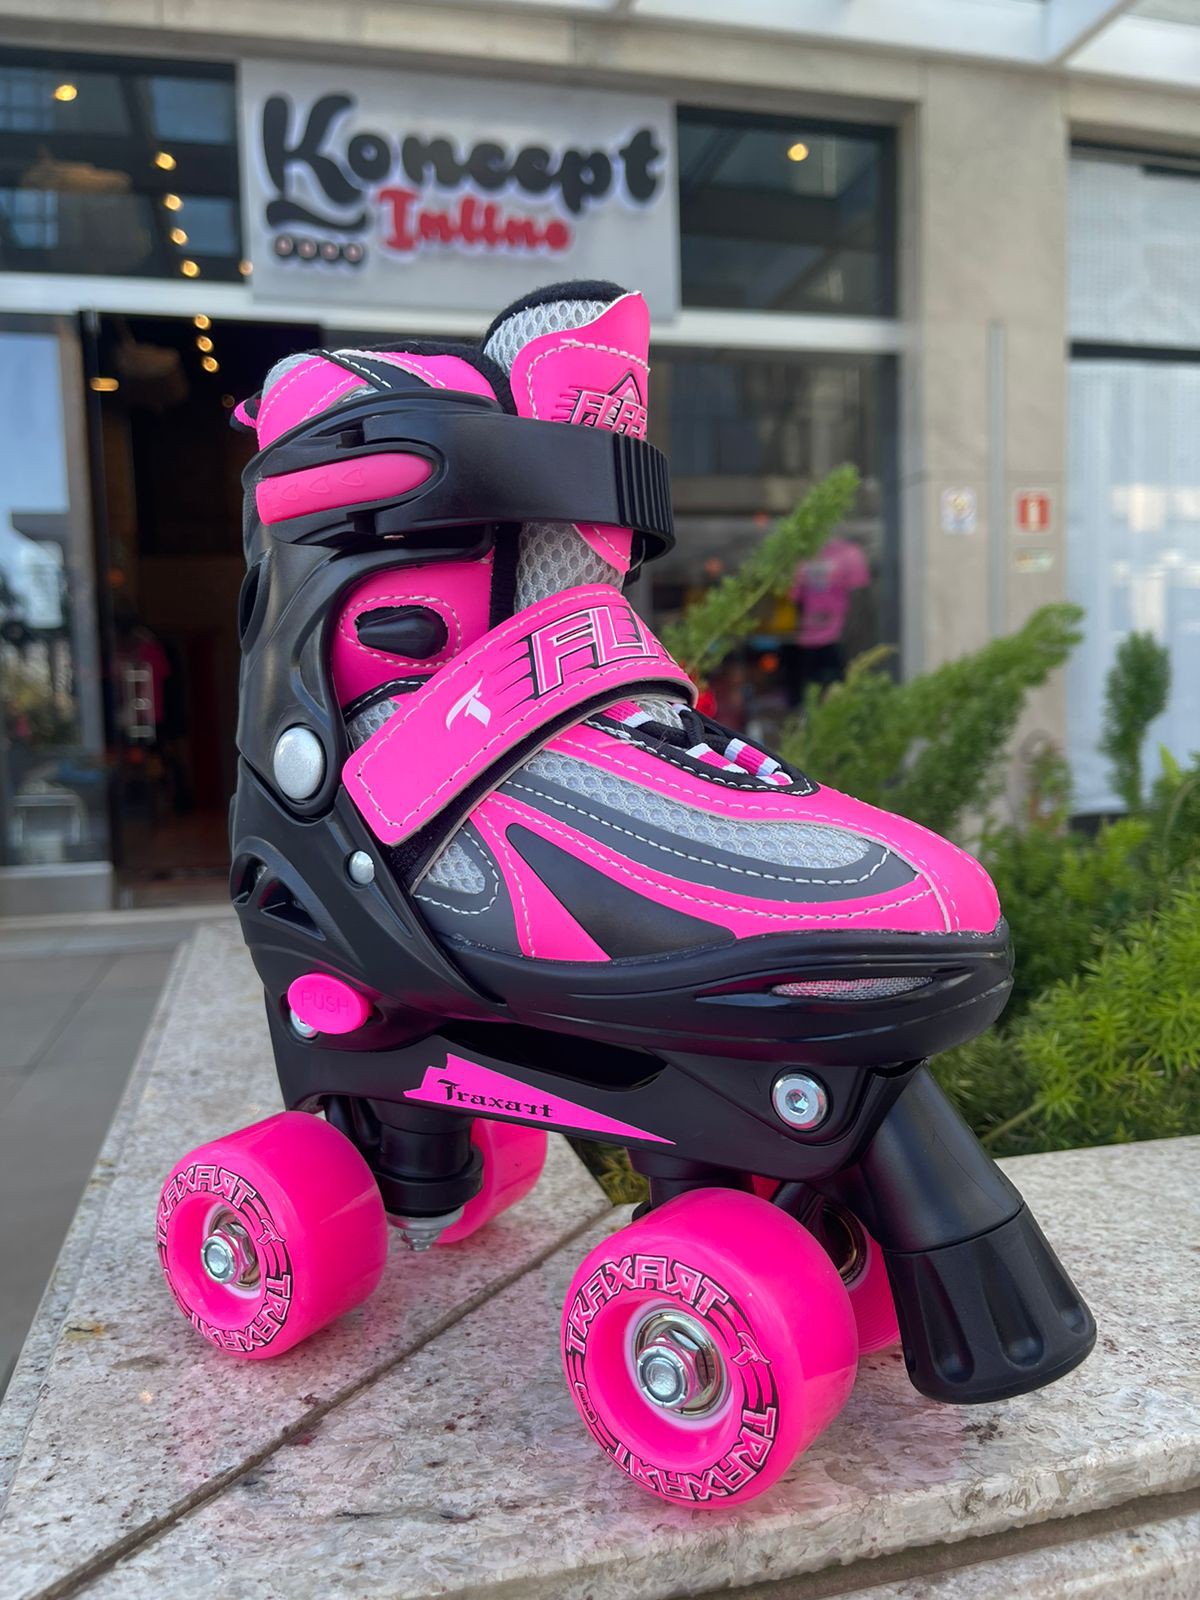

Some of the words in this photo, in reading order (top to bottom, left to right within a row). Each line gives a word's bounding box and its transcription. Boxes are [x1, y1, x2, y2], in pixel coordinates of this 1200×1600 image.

[263, 93, 659, 213] Koncept
[301, 989, 350, 1017] PUSH
[437, 1079, 553, 1118] Traxart
[156, 1164, 257, 1247] TRAXART
[566, 1253, 730, 1355] TRAXART
[606, 1406, 778, 1501] TRAXART
